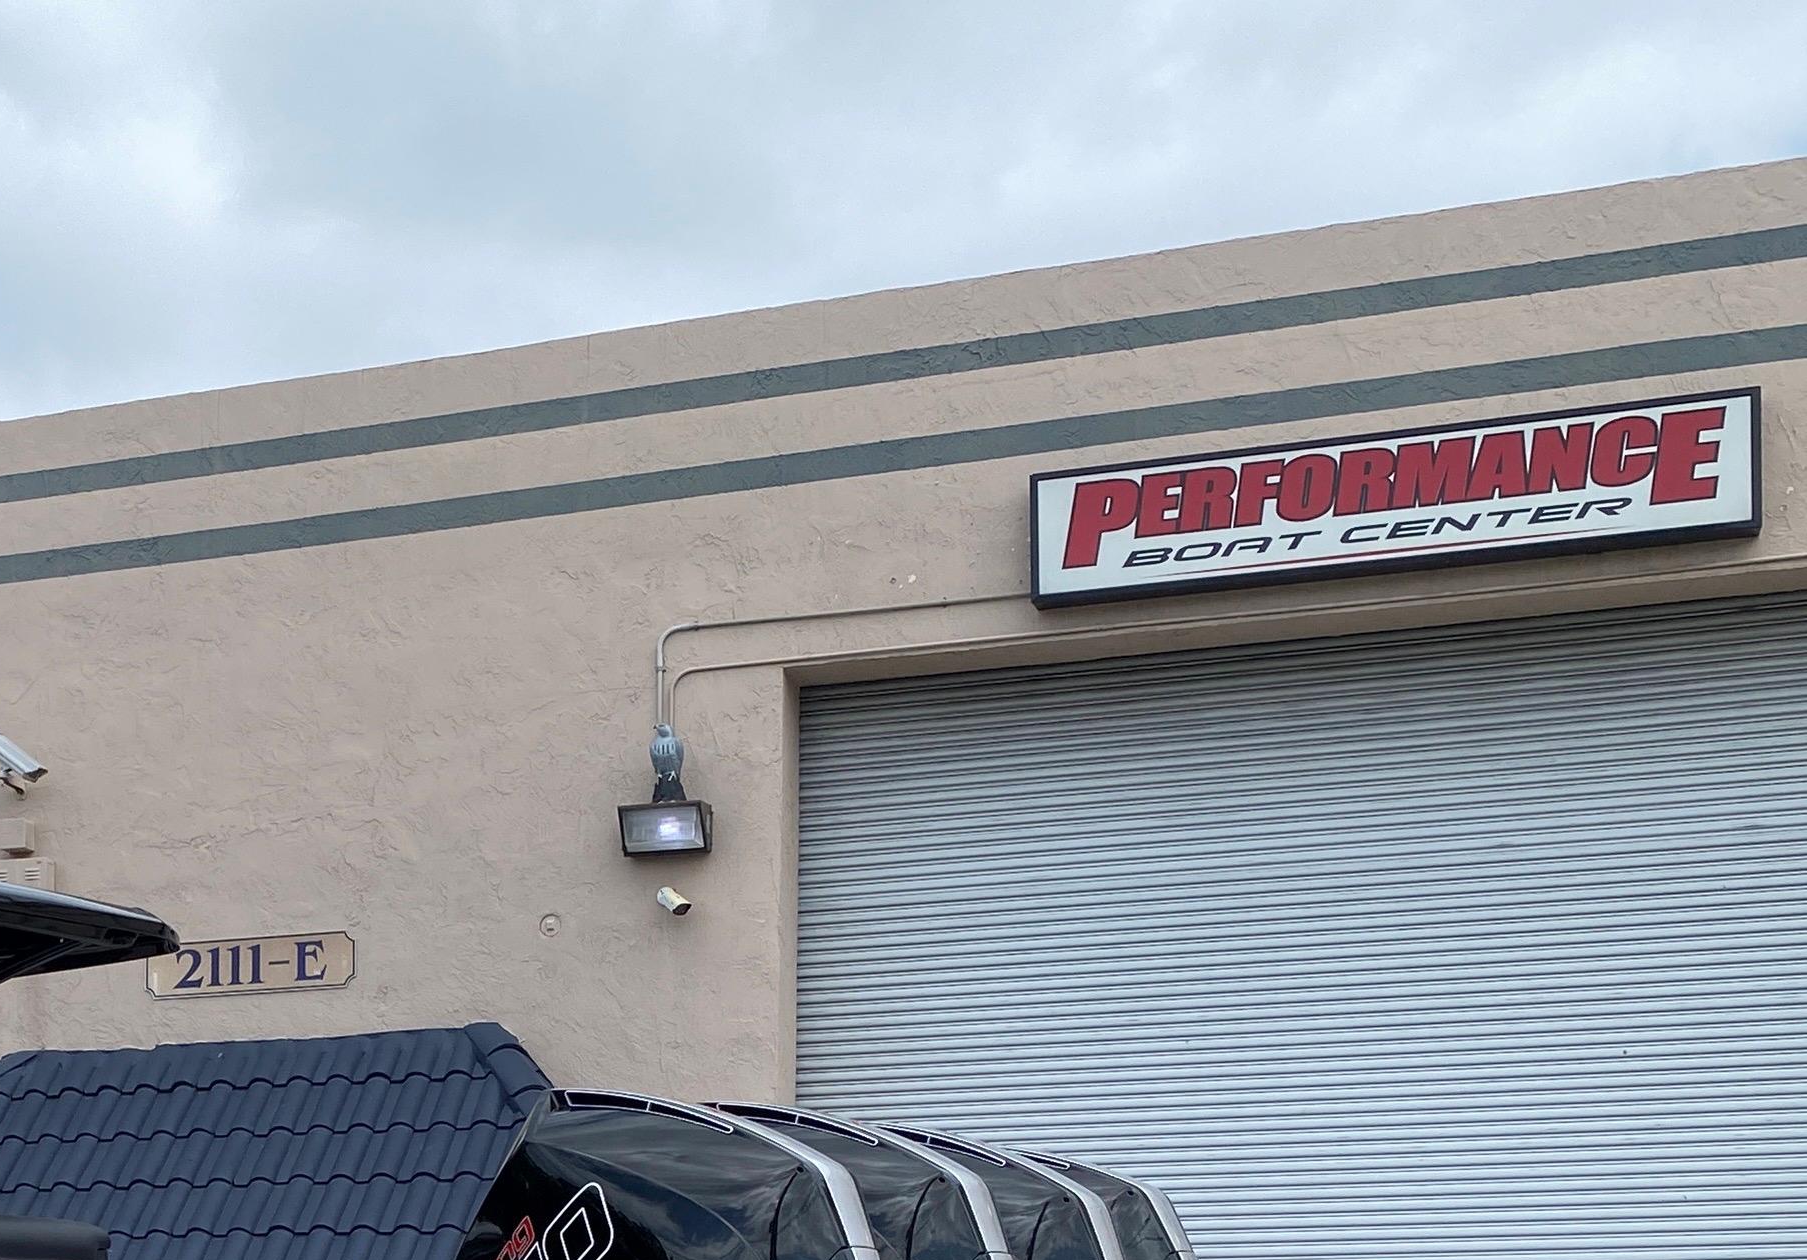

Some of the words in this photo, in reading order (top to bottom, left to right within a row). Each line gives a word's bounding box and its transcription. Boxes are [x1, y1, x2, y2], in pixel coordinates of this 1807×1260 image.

[1061, 405, 1727, 570] PERFORMANCE
[1121, 529, 1323, 569] BOAT
[1339, 496, 1633, 549] CENTER
[172, 939, 328, 990] 2111-E
